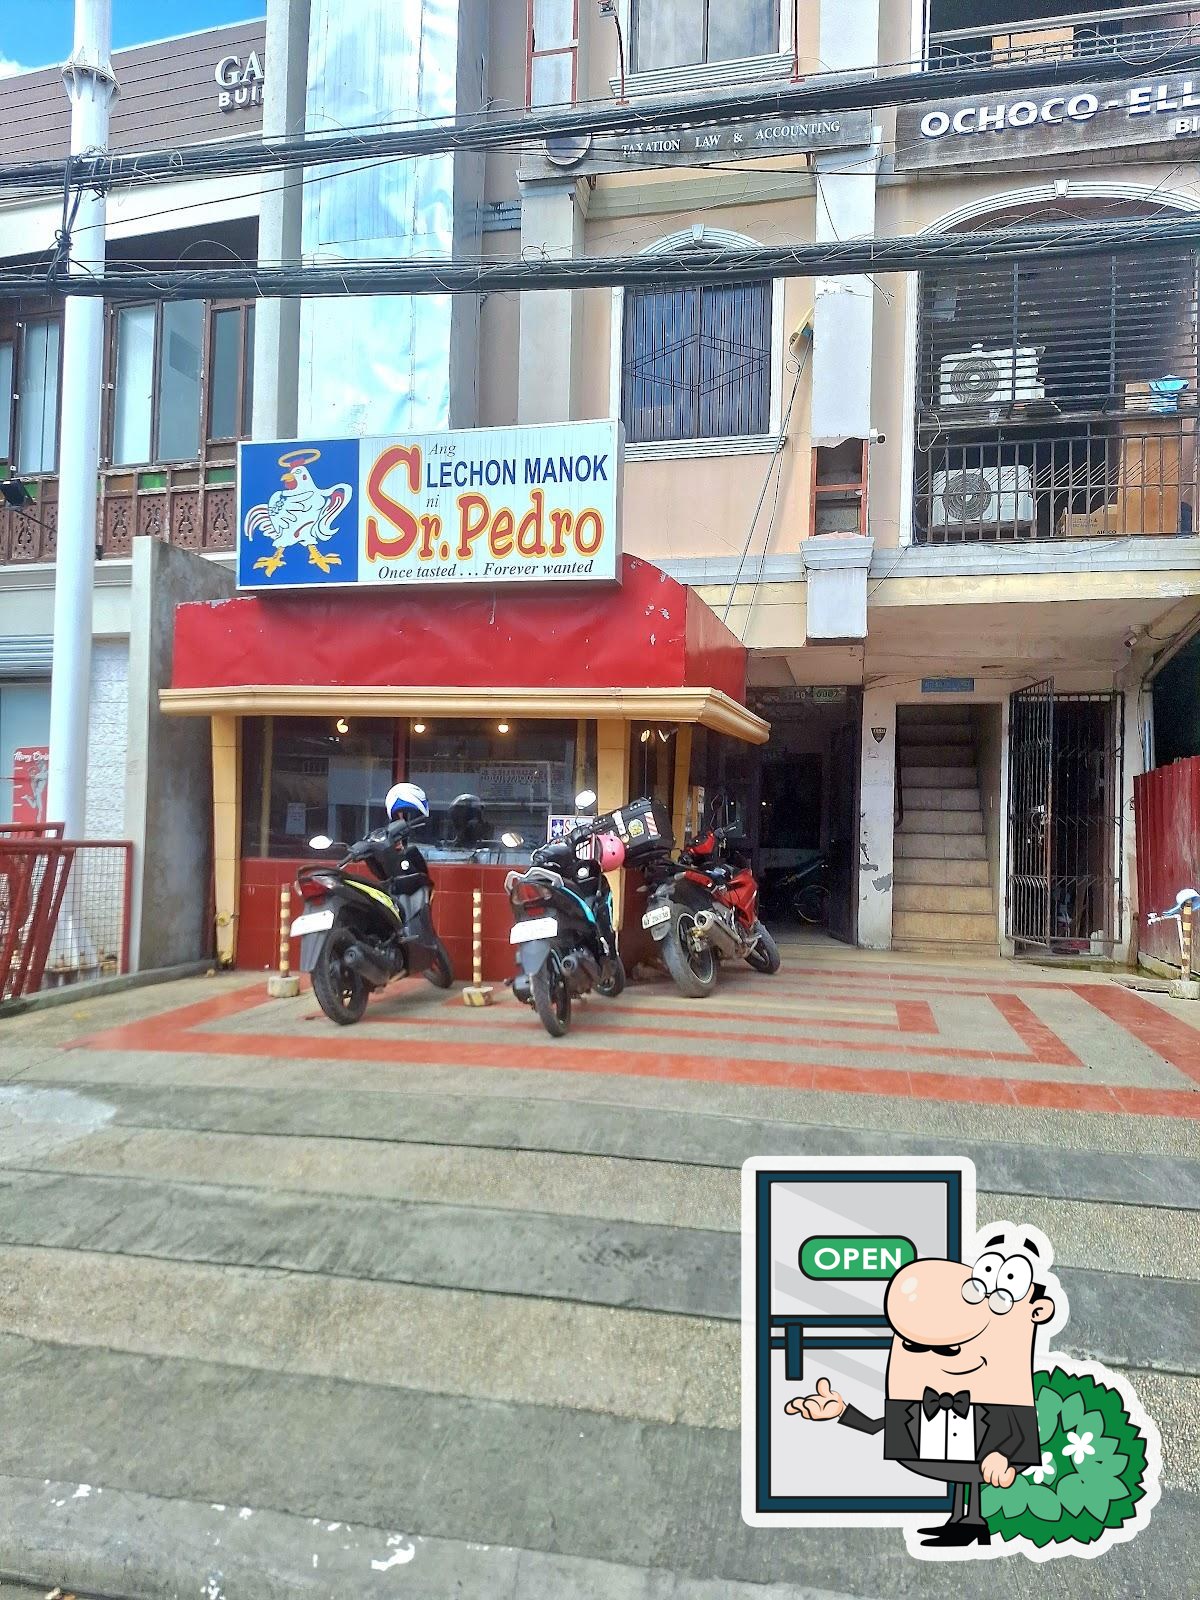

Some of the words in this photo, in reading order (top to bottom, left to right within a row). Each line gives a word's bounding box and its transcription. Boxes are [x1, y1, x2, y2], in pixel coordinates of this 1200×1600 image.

[219, 84, 264, 107] BUI
[621, 139, 681, 155] TAXATION
[695, 135, 722, 148] LAW
[733, 132, 743, 143] &
[755, 121, 841, 140] ACCOUNTING
[428, 443, 457, 457] Ang
[427, 459, 516, 487] LECHON
[524, 454, 609, 484] MANOK
[366, 443, 451, 562] Sr.
[456, 487, 605, 560] Pedro
[426, 494, 440, 508] ni
[378, 566, 413, 579] Once
[416, 563, 457, 577] tasted
[483, 562, 539, 576] Forever
[543, 560, 594, 574] wanted
